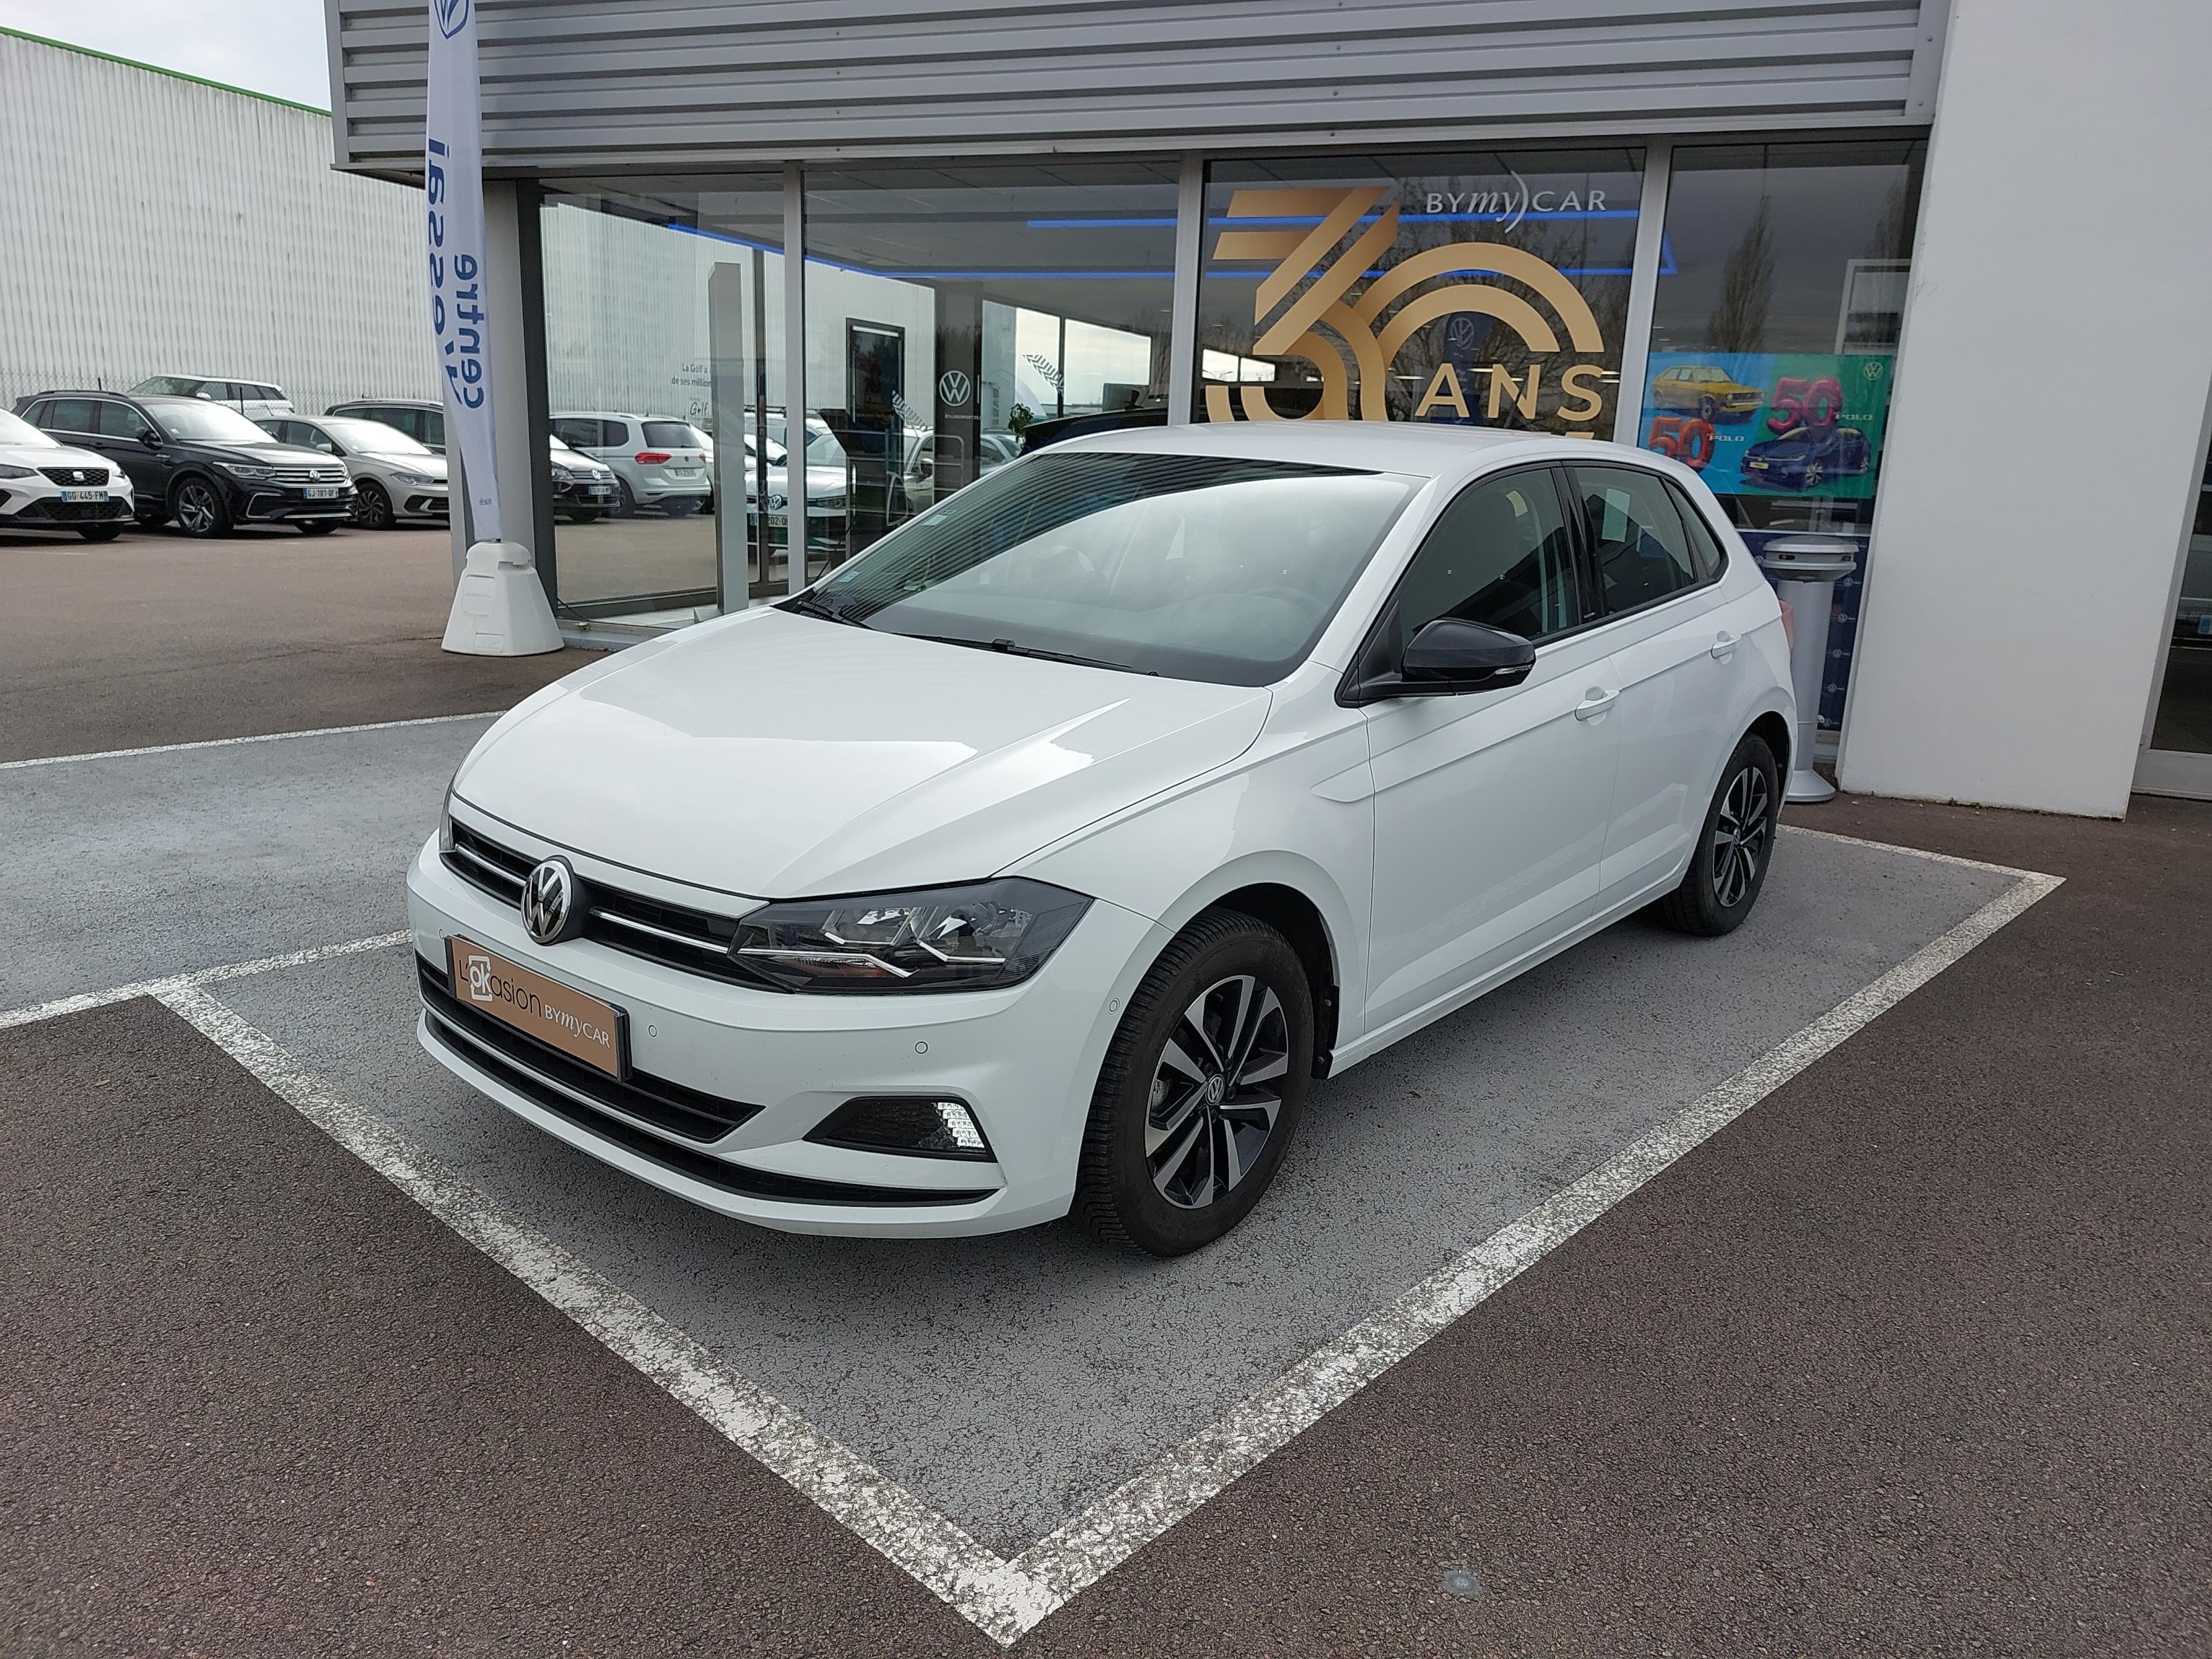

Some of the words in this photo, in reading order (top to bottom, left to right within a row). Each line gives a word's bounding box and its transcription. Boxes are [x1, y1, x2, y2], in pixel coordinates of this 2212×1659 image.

[1415, 363, 1603, 422] ANS
[1767, 377, 1843, 434] 50
[1648, 415, 1715, 469] 50
